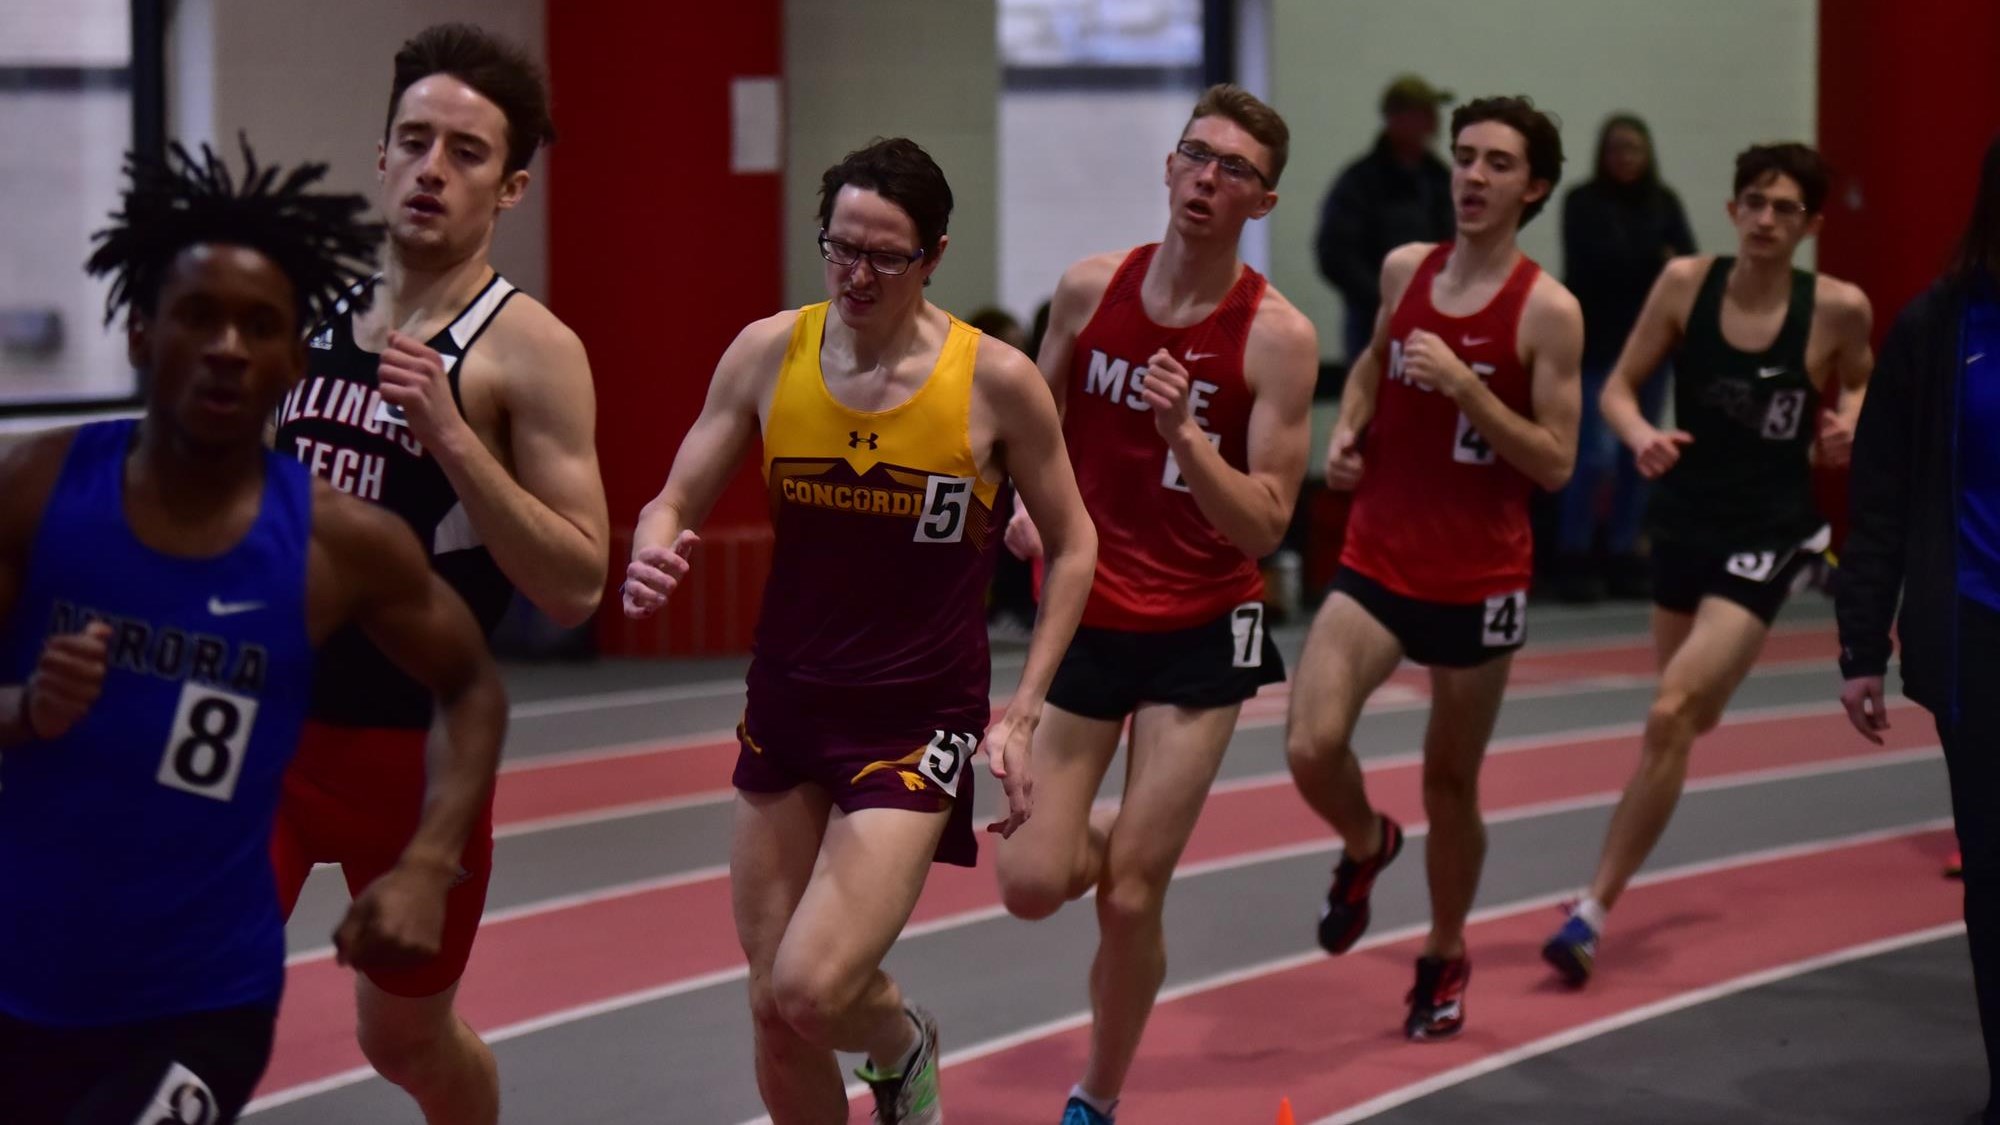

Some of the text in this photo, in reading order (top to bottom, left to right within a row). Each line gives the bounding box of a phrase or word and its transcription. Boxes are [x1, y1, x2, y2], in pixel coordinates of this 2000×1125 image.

[1085, 349, 1219, 426] MSE
[1768, 394, 1797, 434] 3
[295, 435, 386, 500] TECH
[782, 477, 924, 517] CONCORDI
[923, 482, 966, 539] 5
[49, 598, 268, 691] ARORA
[1235, 607, 1259, 663] 7
[1488, 596, 1519, 640] 4
[173, 697, 240, 788] 8
[928, 730, 970, 784] 5
